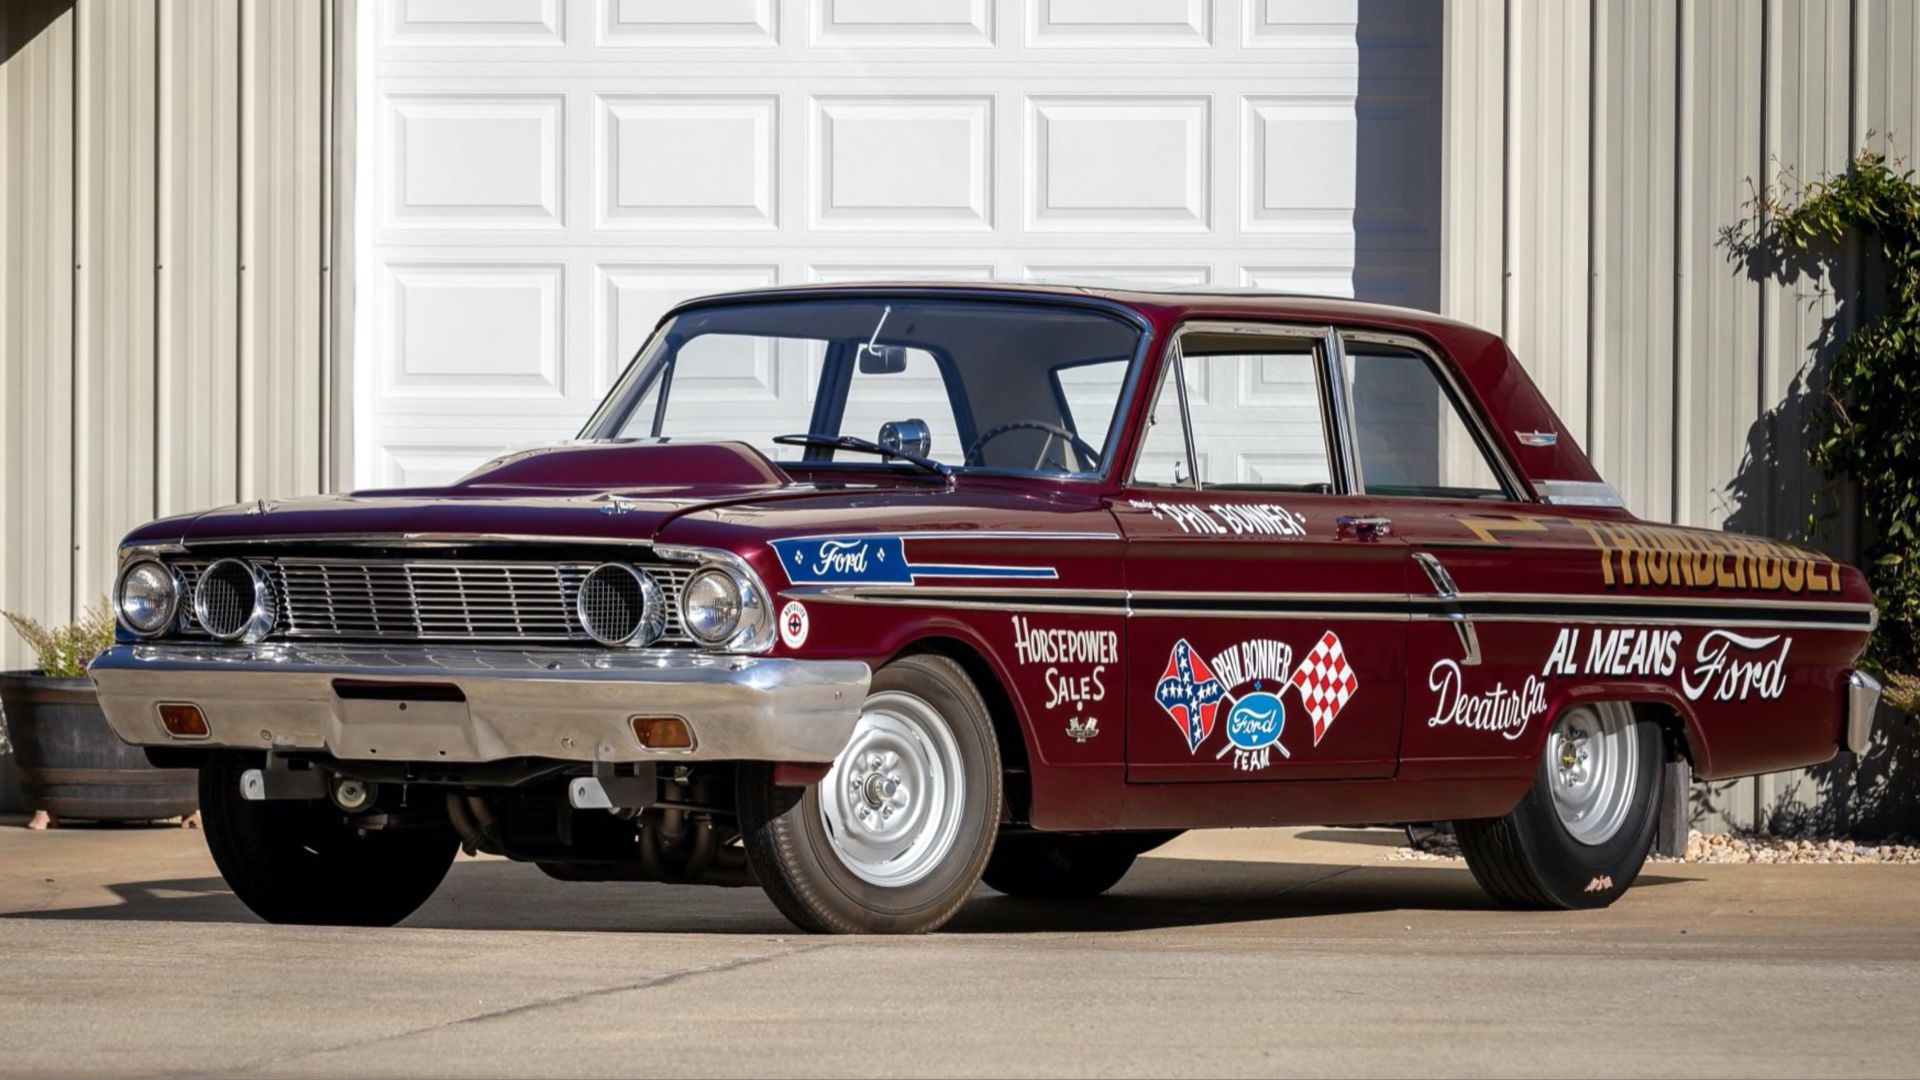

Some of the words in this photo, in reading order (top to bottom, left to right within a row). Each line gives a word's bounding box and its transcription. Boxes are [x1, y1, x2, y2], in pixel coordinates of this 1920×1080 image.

[1156, 503, 1228, 534] PHIL
[812, 539, 868, 575] Ford
[1011, 615, 1118, 665] HORSEPOWER
[1211, 644, 1245, 692] PHIL
[1242, 639, 1292, 684] BONNER
[1541, 628, 1579, 676] AL
[1584, 629, 1683, 676] MEANS
[1681, 629, 1793, 701] Ford
[1045, 665, 1105, 709] SALES
[1232, 708, 1277, 734] Ford
[1233, 747, 1271, 772] TEAM
